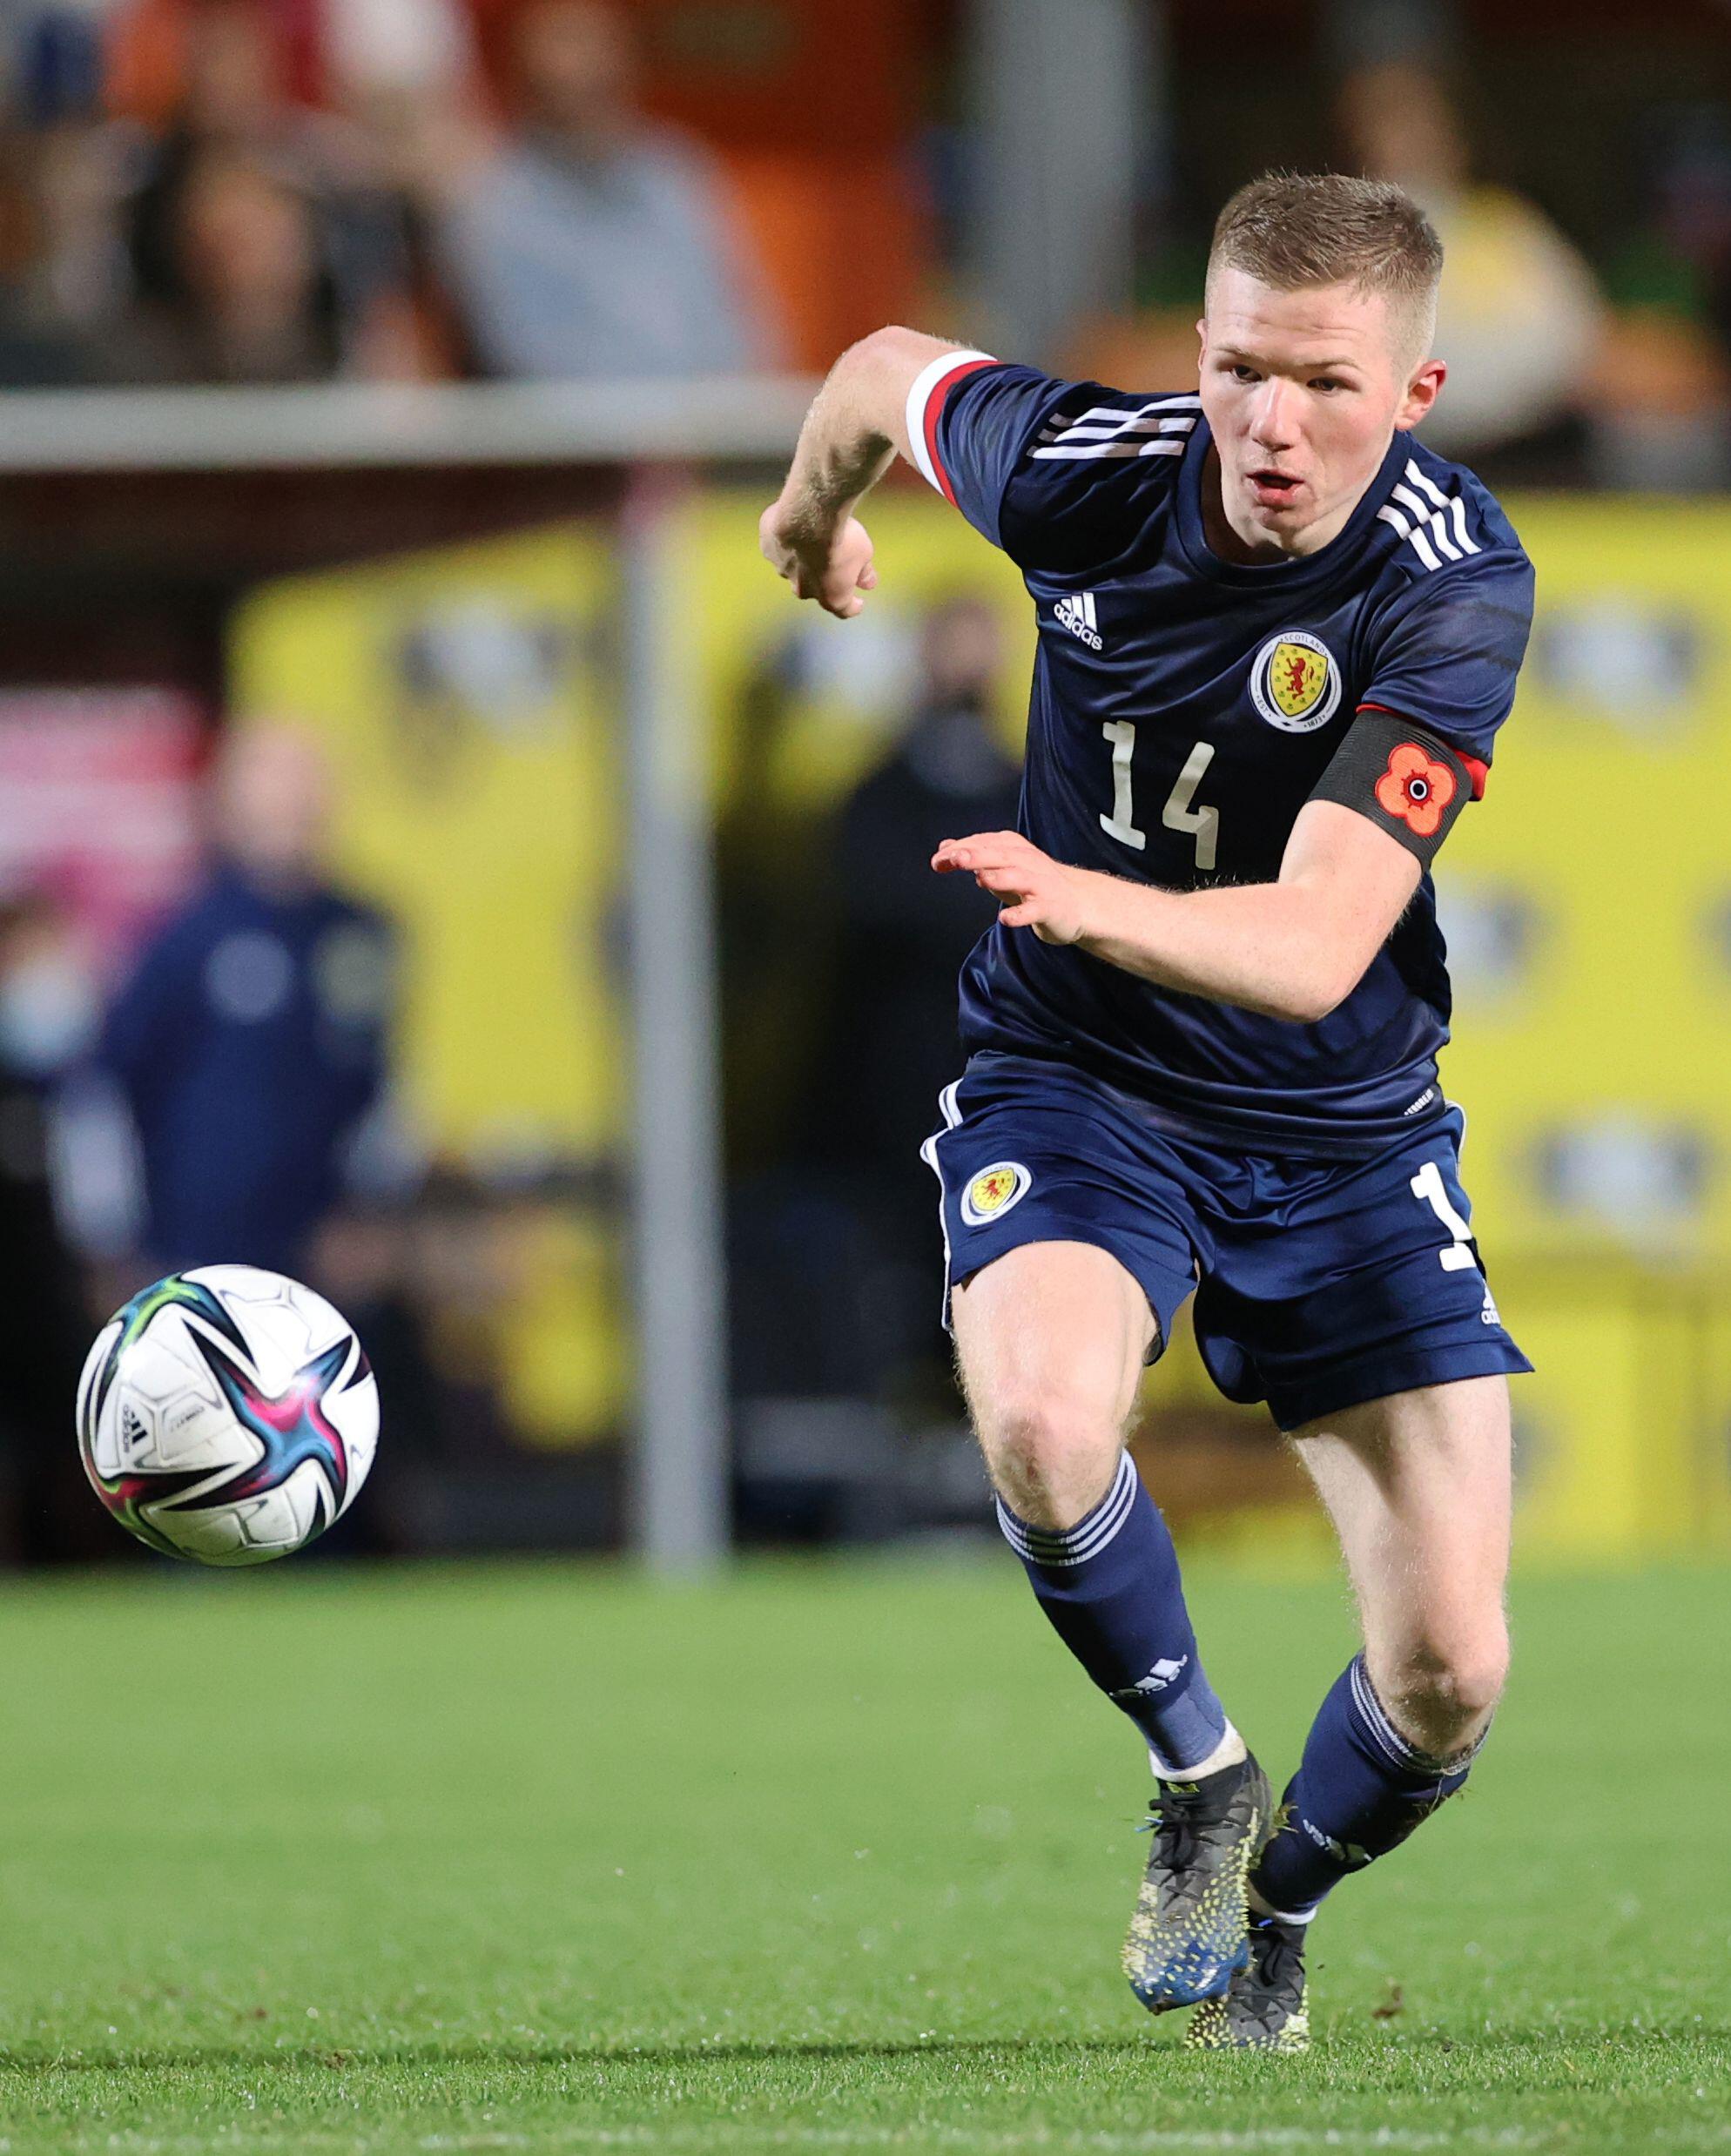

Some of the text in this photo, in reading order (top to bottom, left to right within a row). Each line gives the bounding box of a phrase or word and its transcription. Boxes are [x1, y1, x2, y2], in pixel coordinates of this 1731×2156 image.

[1054, 603, 1103, 650] adidas
[1284, 634, 1325, 653] SCOTLAND
[1100, 720, 1219, 870] 14
